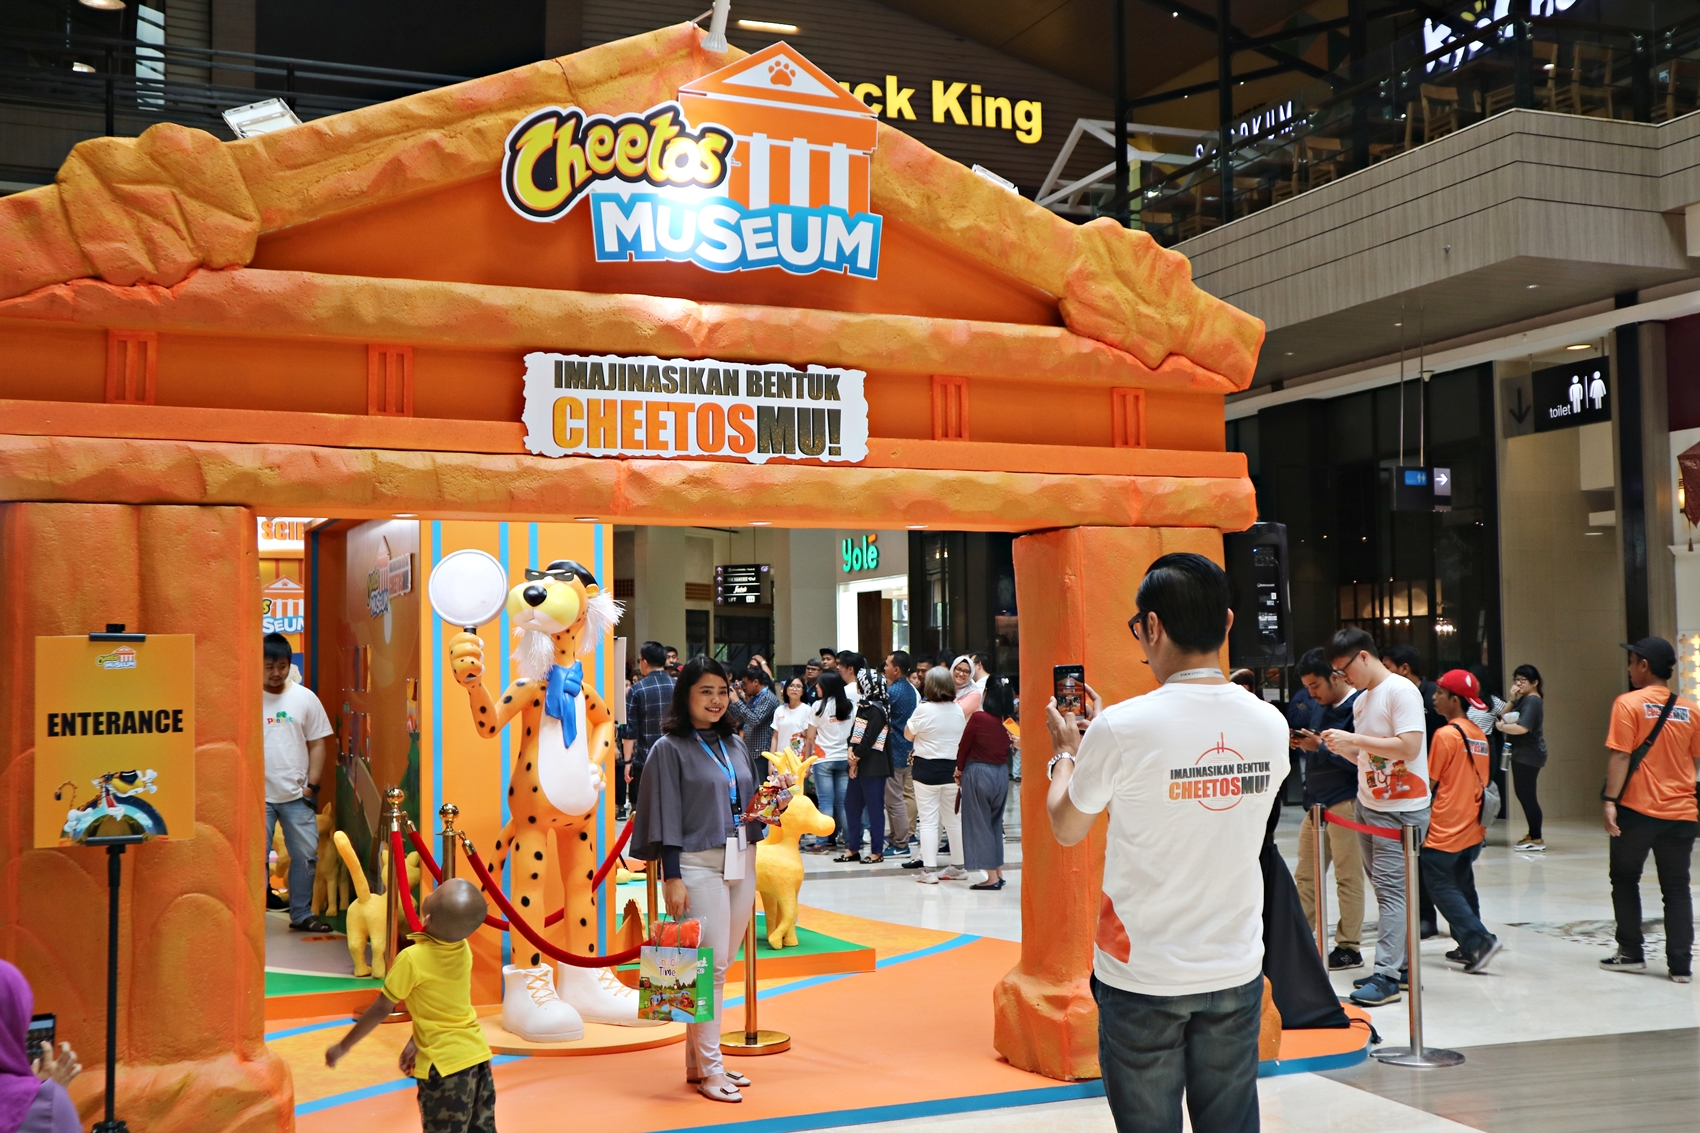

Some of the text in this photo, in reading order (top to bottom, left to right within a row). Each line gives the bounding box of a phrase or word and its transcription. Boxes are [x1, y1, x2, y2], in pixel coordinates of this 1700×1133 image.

[839, 75, 1043, 144] ck King
[507, 104, 733, 215] Cheetos
[598, 195, 877, 272] MUSEUM
[554, 360, 841, 401] IMAJINASIKAN BENTUK
[552, 396, 842, 456] CHEETOSMU!
[1549, 404, 1571, 418] toilet
[47, 709, 183, 737] ENTERANCE
[1169, 774, 1270, 800] CHEETOSMU!
[1170, 761, 1270, 780] IMAJINASIKAN BENTUK
